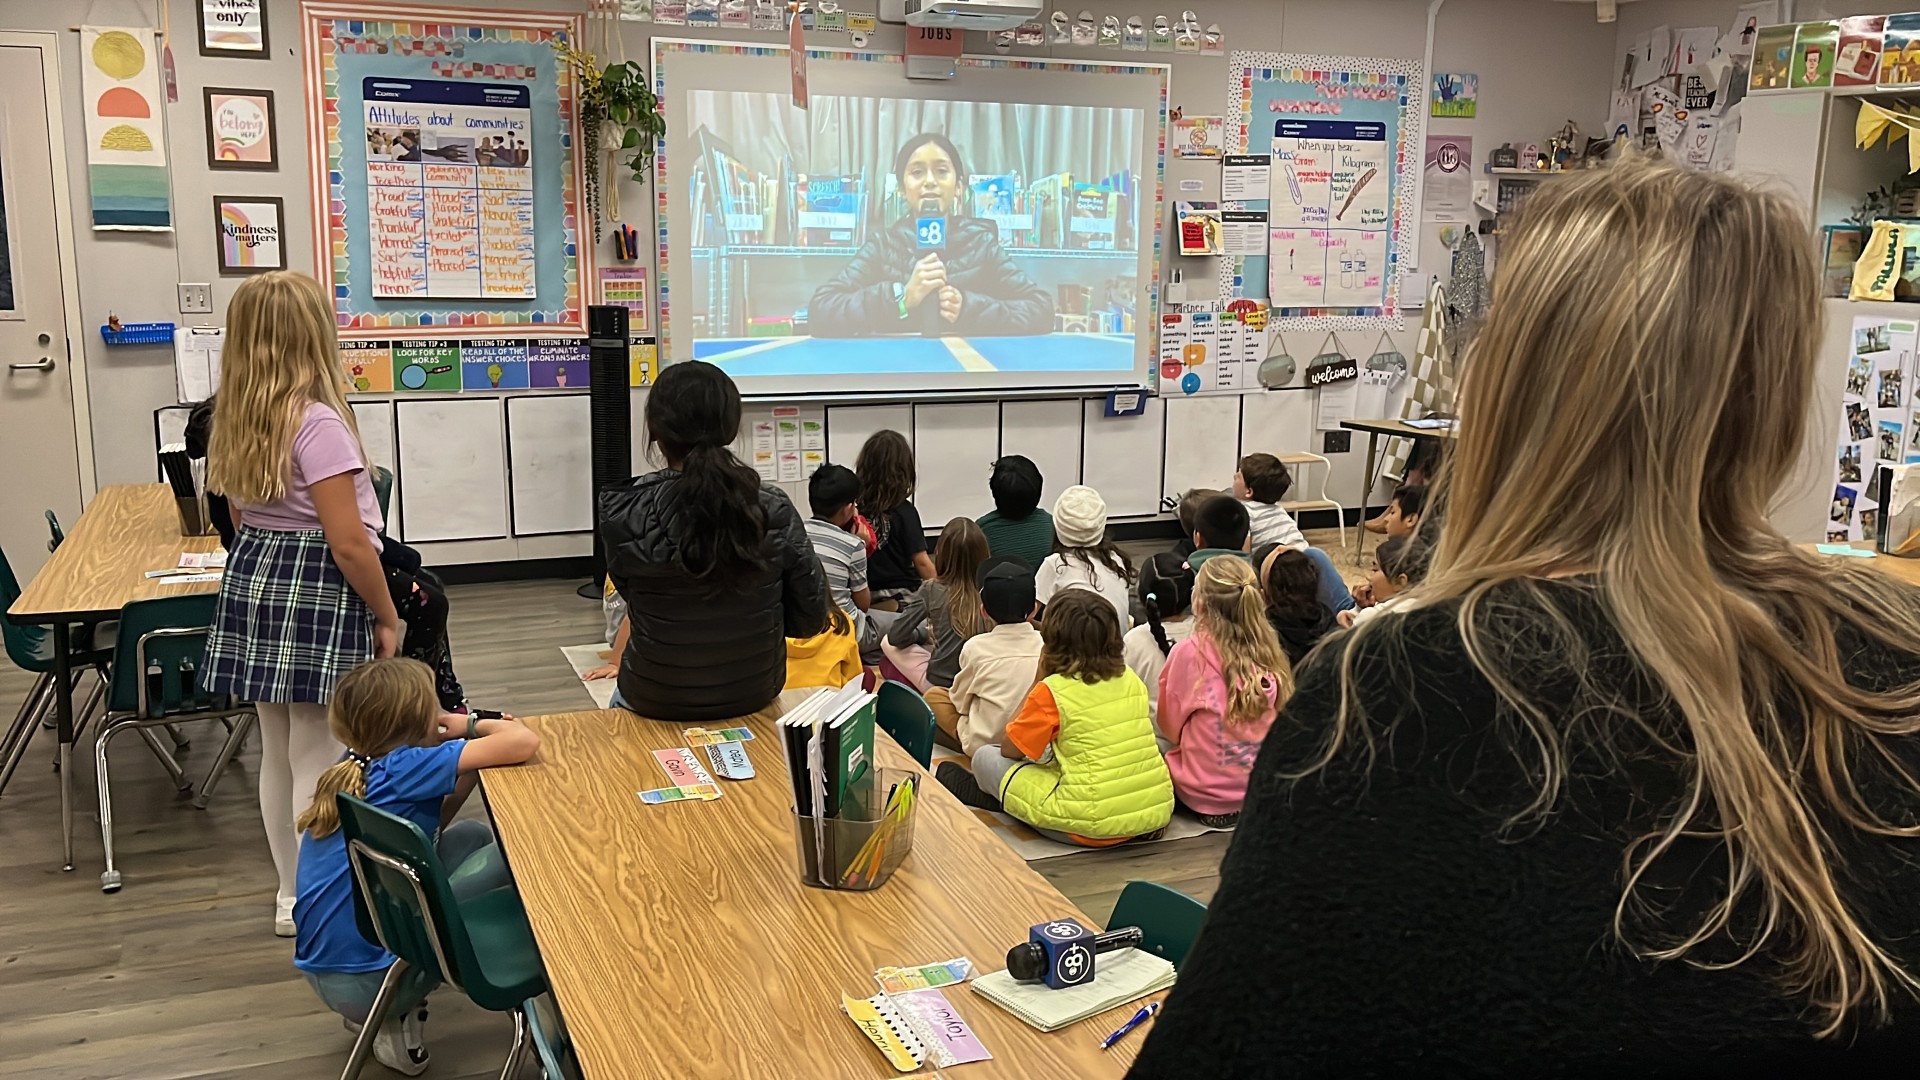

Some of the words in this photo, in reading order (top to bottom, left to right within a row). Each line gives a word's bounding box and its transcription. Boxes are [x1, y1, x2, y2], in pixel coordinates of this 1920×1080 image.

[216, 12, 250, 26] only
[920, 27, 952, 41] JOBS
[1686, 97, 1708, 107] EVER
[220, 112, 264, 136] belong
[369, 106, 420, 125] Attitudes
[427, 110, 454, 126] about
[465, 116, 524, 130] communities
[1298, 138, 1320, 150] When
[1322, 143, 1335, 154] you
[1272, 148, 1296, 160] Mass
[1342, 156, 1376, 172] Kilogram
[222, 223, 277, 237] kindness
[235, 234, 277, 248] matters
[1172, 303, 1204, 314] Partner
[1211, 300, 1226, 312] Talk
[402, 340, 426, 348] TESTING
[428, 340, 438, 348] TIP
[462, 348, 483, 356] READ
[509, 347, 525, 355] THE
[528, 354, 555, 362] WRONG
[495, 355, 527, 363] CHOICES
[1312, 366, 1356, 384] welcome
[666, 760, 685, 777] Gavin
[934, 1008, 967, 1042] Taylor
